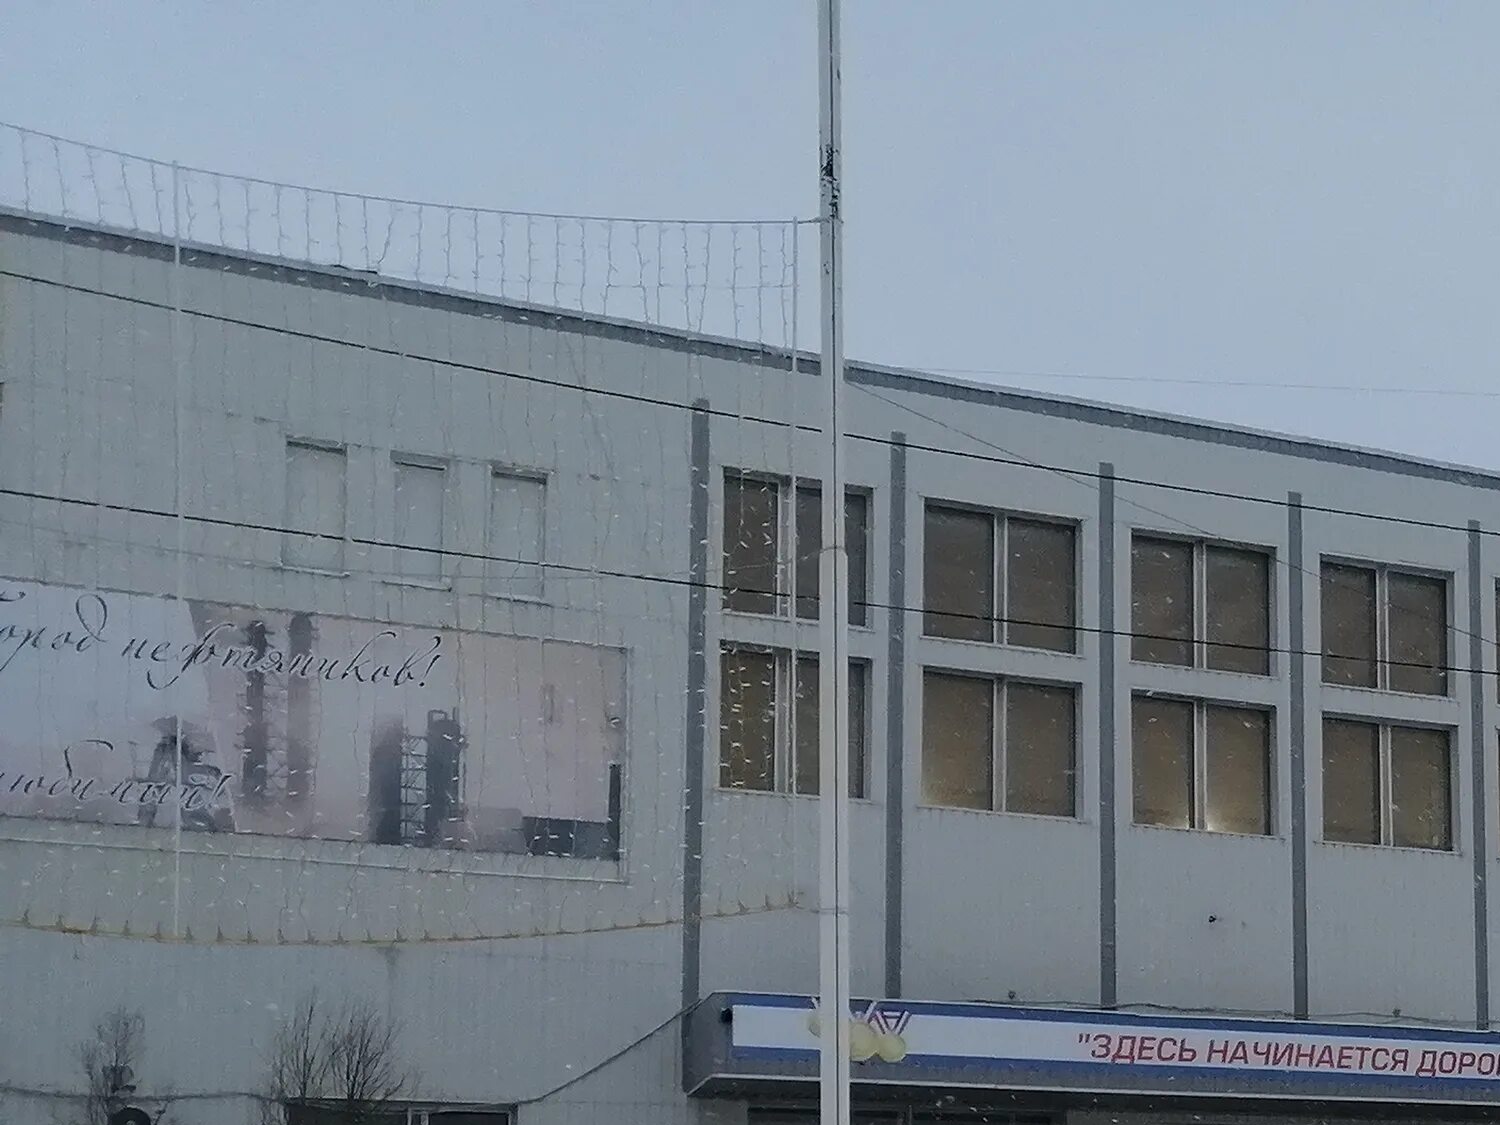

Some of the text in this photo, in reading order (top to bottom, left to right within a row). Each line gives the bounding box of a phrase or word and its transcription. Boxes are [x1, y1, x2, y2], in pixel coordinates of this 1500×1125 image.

[0, 592, 441, 691] ород нефтяников!
[0, 739, 231, 810] юбимый!
[1078, 1033, 1197, 1065] "ЗДЕСЬ
[1207, 1038, 1410, 1072] НАЧИНАЕТСЯ
